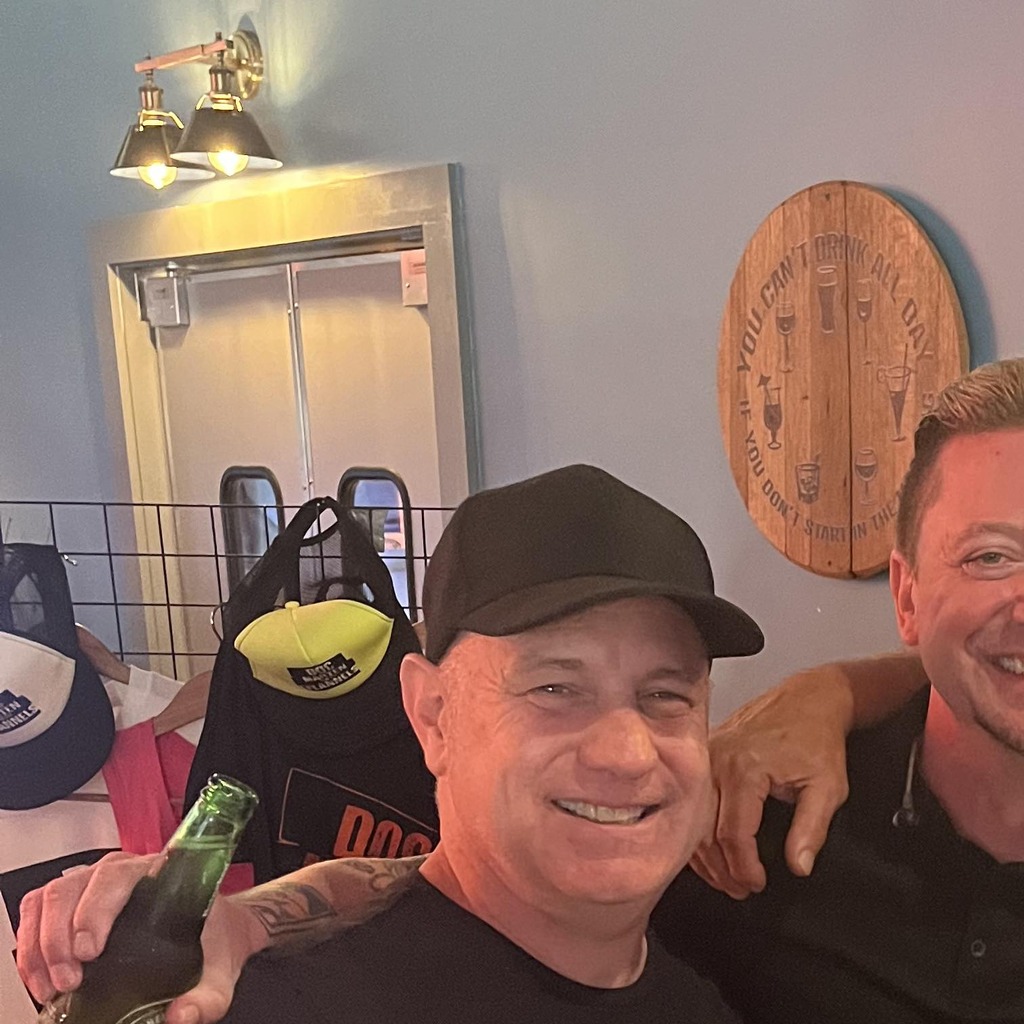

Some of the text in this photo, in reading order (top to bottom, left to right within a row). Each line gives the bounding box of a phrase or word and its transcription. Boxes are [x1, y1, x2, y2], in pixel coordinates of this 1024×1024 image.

[736, 232, 935, 373] YOU CAN'T DRINK ALL DAY
[745, 430, 766, 477] YOU
[761, 479, 801, 528] DON'T
[803, 519, 848, 543] START
[851, 523, 868, 540] IN
[870, 504, 899, 531] THE
